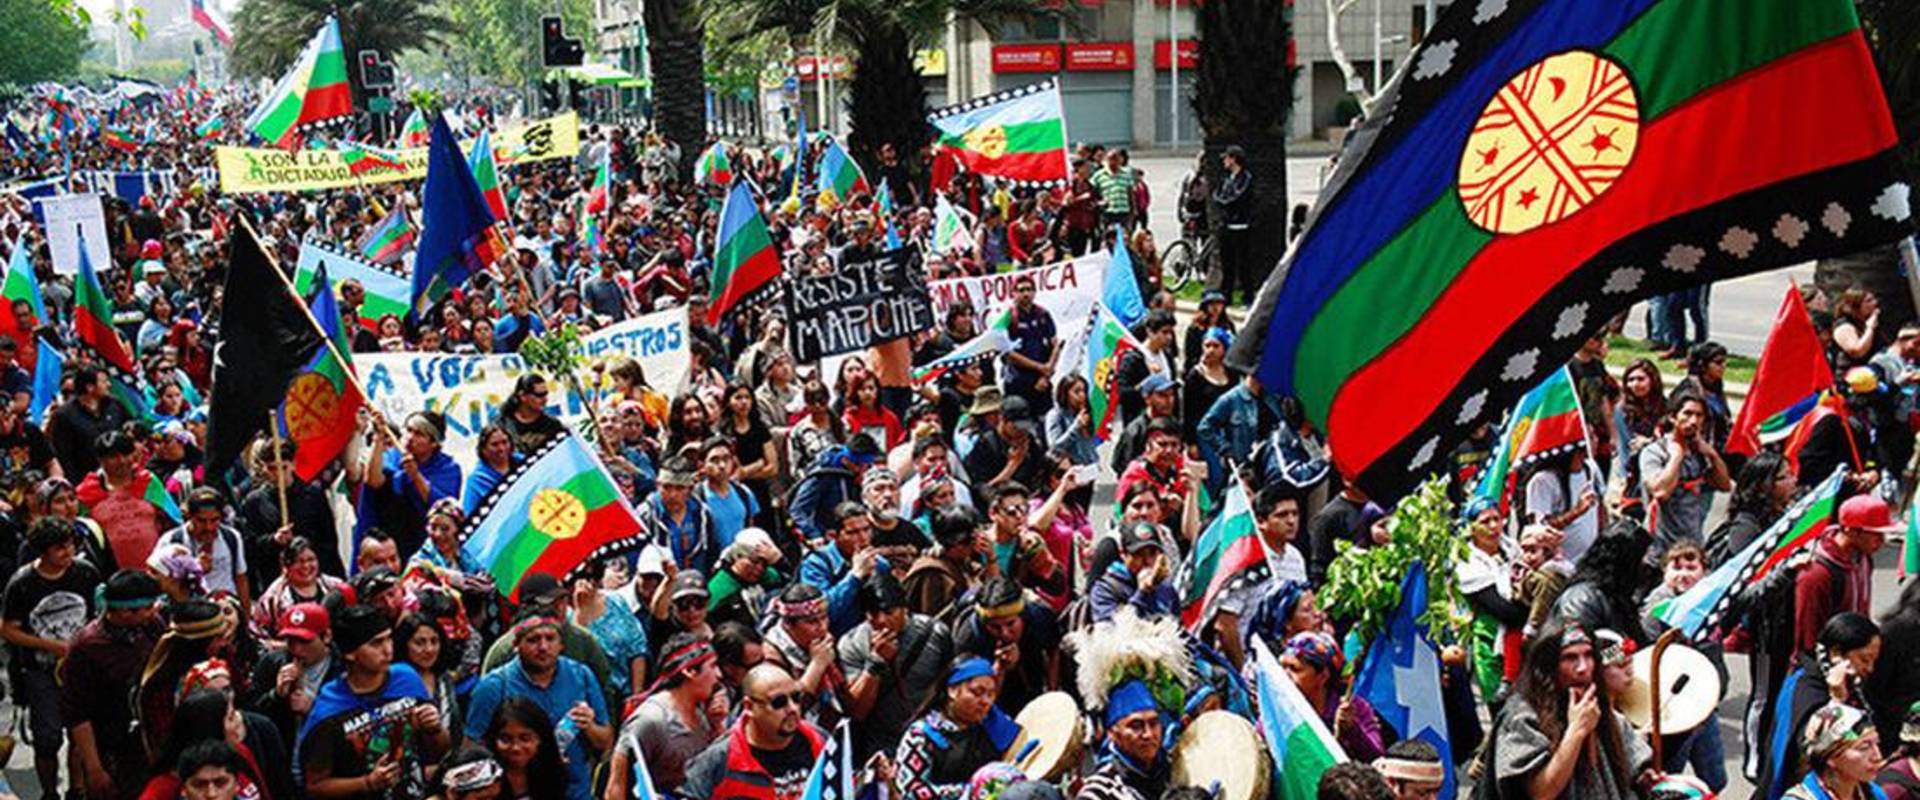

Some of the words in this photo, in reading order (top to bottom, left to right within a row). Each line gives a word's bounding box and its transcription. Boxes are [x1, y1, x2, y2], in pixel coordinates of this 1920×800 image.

[308, 153, 330, 164] LA
[790, 258, 898, 314] RESISTE
[796, 295, 925, 360] MAPUCHE
